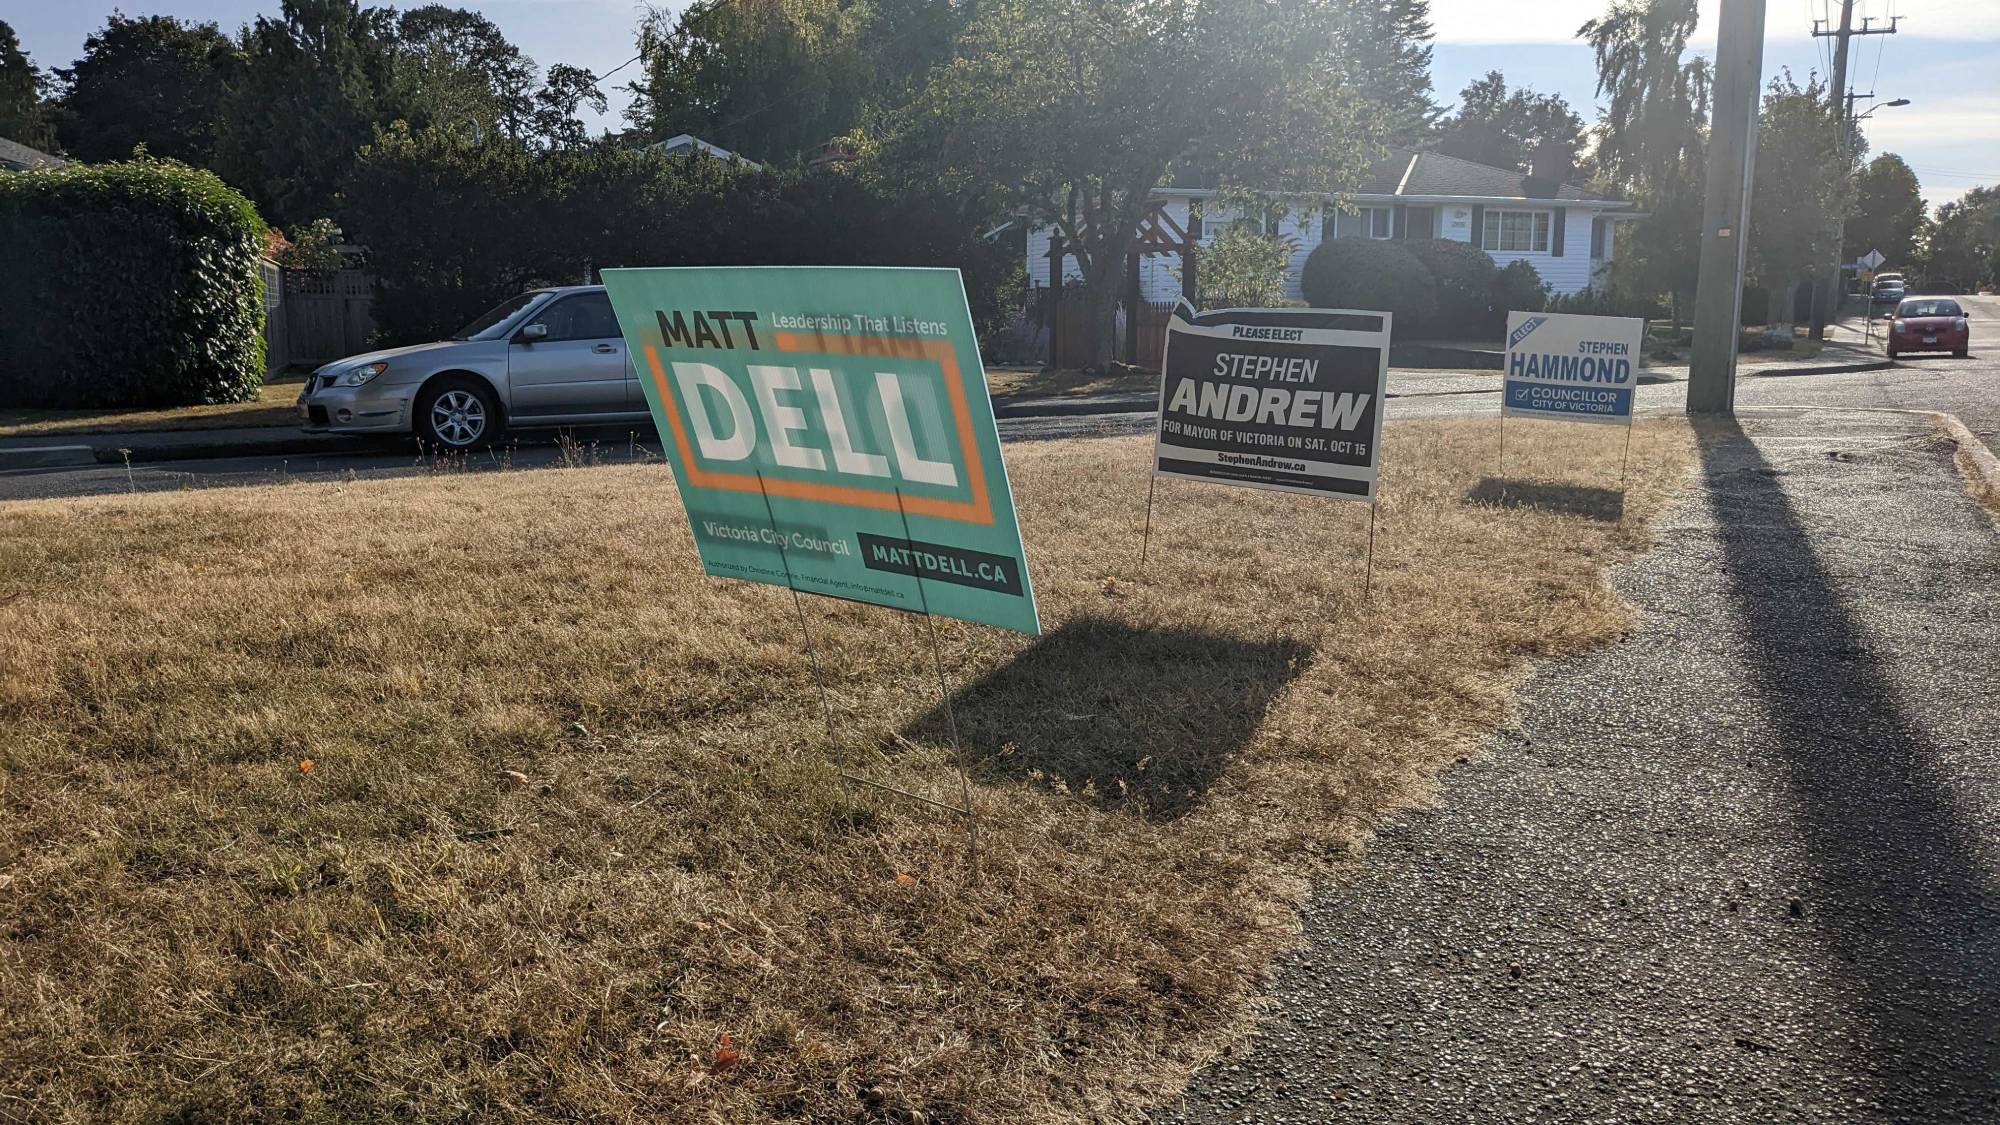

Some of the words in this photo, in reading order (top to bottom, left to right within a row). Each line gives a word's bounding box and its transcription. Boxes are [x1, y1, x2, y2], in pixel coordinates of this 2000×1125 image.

[656, 311, 760, 350] MATT
[772, 312, 851, 333] Leadership
[853, 314, 890, 332] That
[893, 316, 948, 336] Listens
[1233, 326, 1271, 340] PLEASE
[1272, 328, 1303, 342] ELECT
[1513, 318, 1538, 342] ELECT
[1578, 340, 1629, 356] STEPHEN
[1213, 353, 1319, 383] STEPHEN
[1509, 352, 1630, 384] HAMMOND
[1167, 377, 1371, 431] ANDREW
[1531, 387, 1617, 403] COUNCILLOR
[1532, 400, 1553, 409] CITY
[1555, 401, 1567, 410] OF
[1569, 403, 1614, 413] VICTORIA
[671, 361, 959, 487] DELL
[1162, 419, 1181, 435] FOR
[1183, 424, 1217, 441] MAYOR
[1220, 429, 1233, 442] OF
[1236, 431, 1285, 447] VICTORIA
[1287, 435, 1302, 449] ON
[1304, 437, 1327, 452] SAT.
[1330, 440, 1352, 454] OCT
[1354, 443, 1366, 456] 15
[1217, 452, 1306, 472] StephenAndrew.ca
[703, 521, 758, 542] Victoria
[760, 528, 789, 550] City
[792, 533, 850, 556] Council
[872, 544, 1008, 584] MATTDELL.CA
